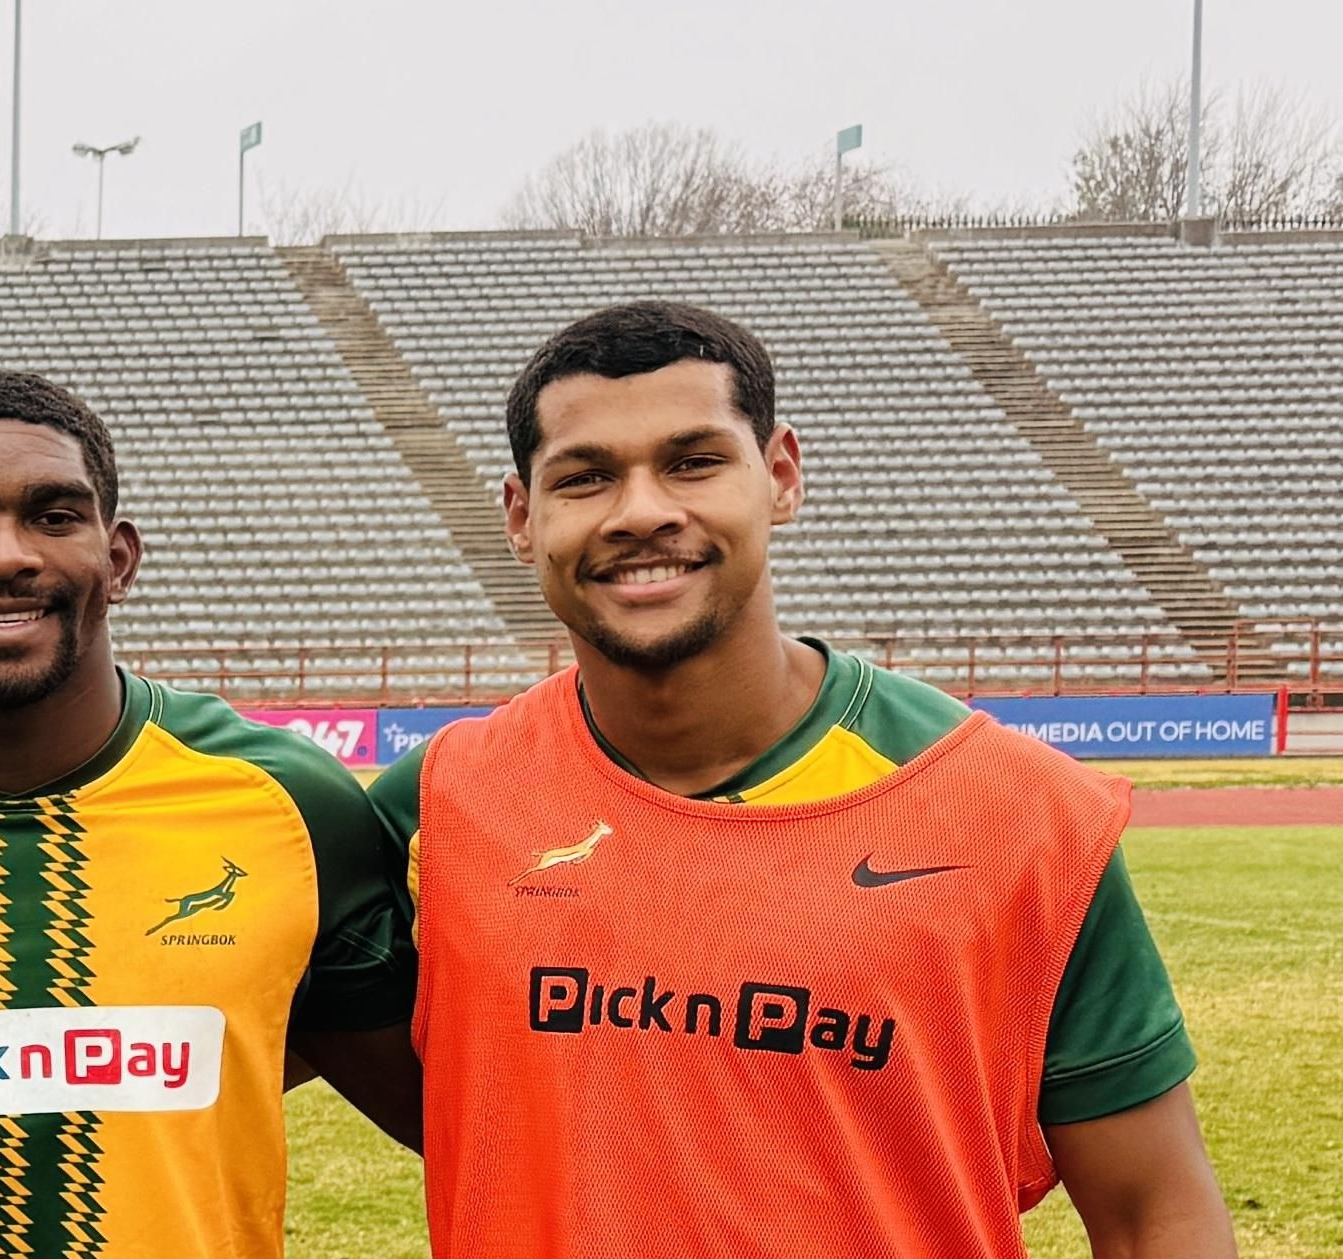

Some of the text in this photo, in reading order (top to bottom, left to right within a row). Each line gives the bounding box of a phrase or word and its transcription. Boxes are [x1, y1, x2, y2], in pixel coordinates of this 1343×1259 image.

[1107, 720, 1156, 742] OUT
[1159, 720, 1193, 742] OF
[1196, 719, 1265, 742] HOME
[160, 933, 237, 947] SPRINGBOK
[529, 966, 895, 1071] Pick n Pay
[20, 1043, 53, 1079] n
[64, 1028, 191, 1089] Pay
